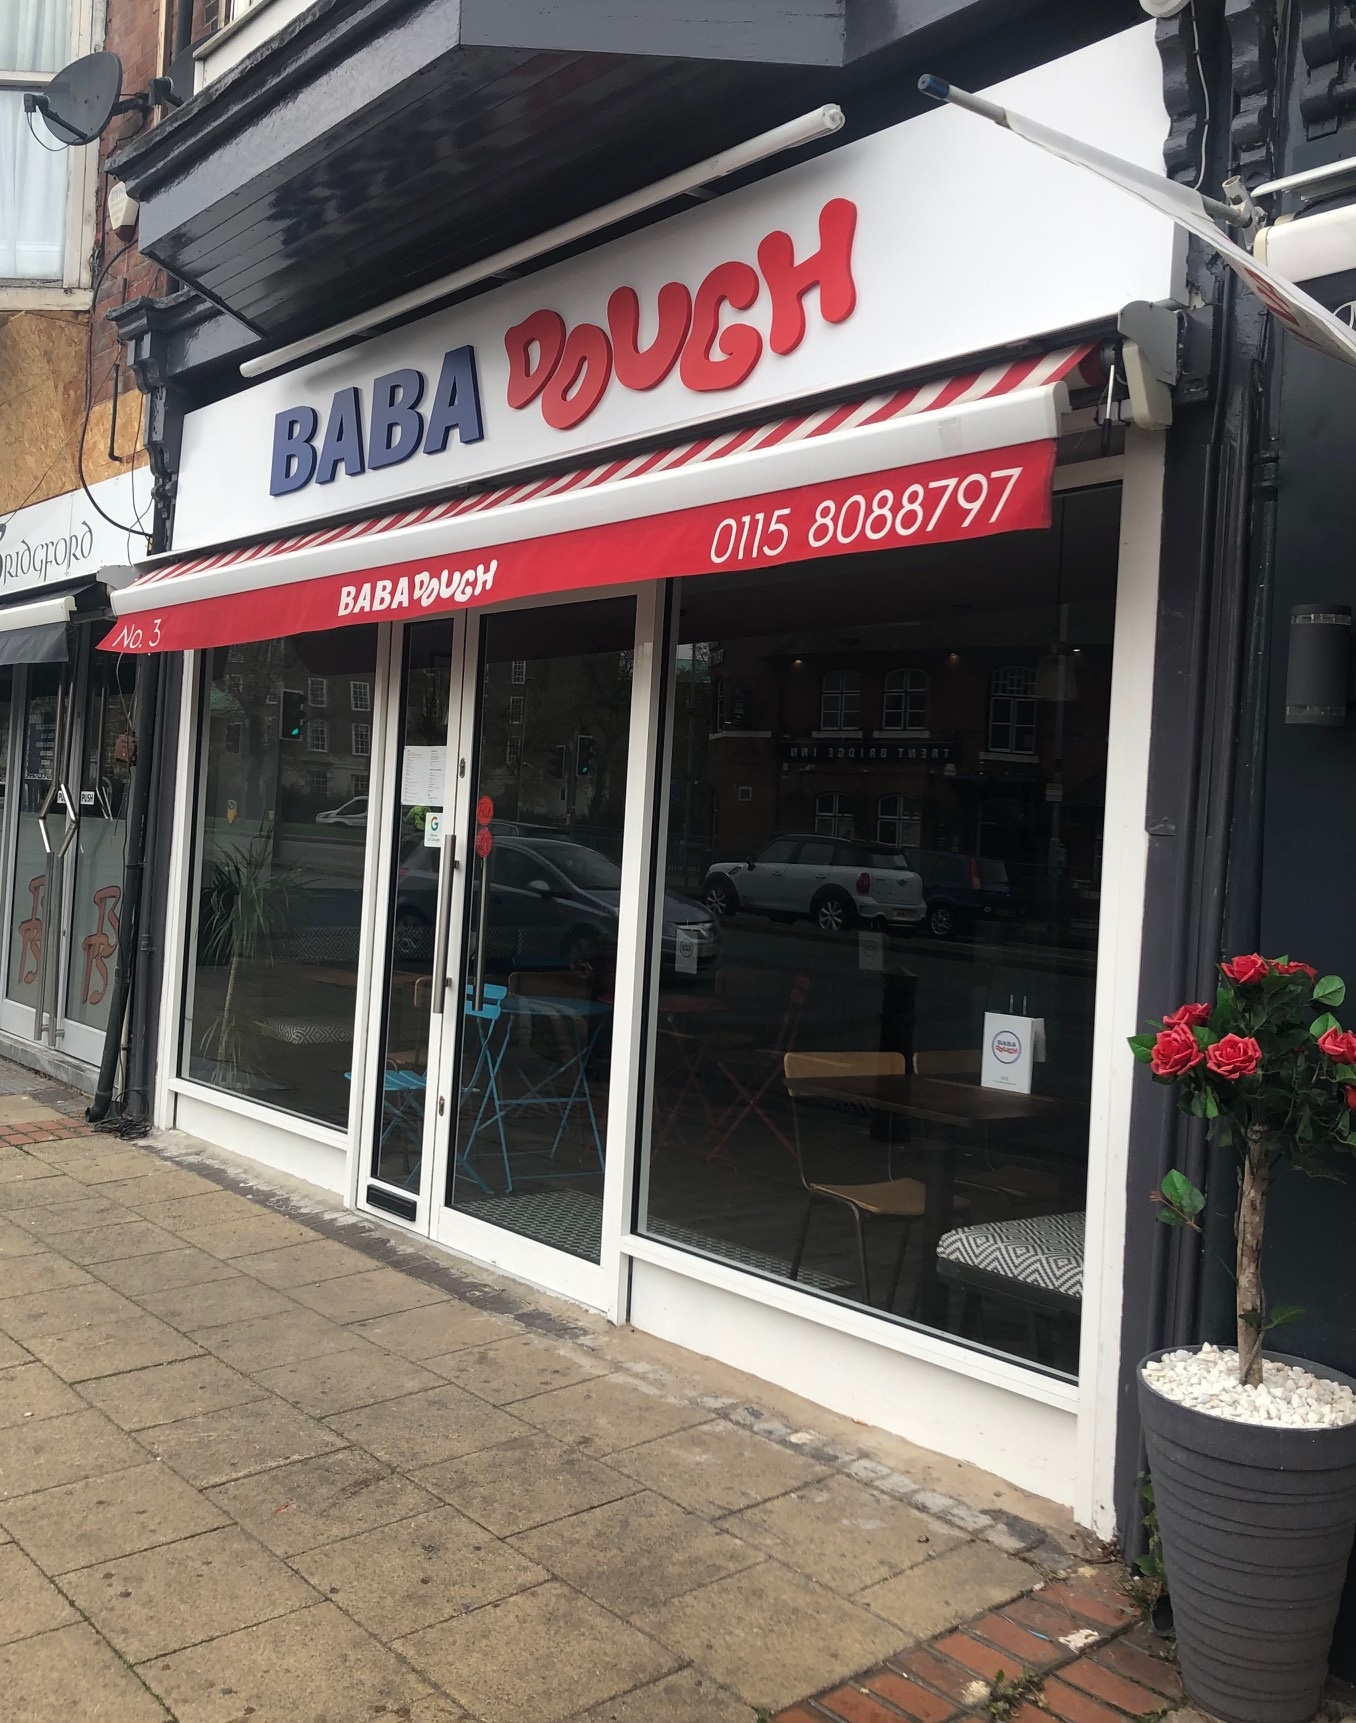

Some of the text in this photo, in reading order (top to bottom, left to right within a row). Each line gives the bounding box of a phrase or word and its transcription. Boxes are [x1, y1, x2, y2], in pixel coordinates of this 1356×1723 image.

[270, 197, 858, 497] BABA DOUGH
[710, 466, 1024, 564] 0115 8088797
[337, 559, 498, 616] BABA DOUGH
[112, 618, 162, 649] No. 3
